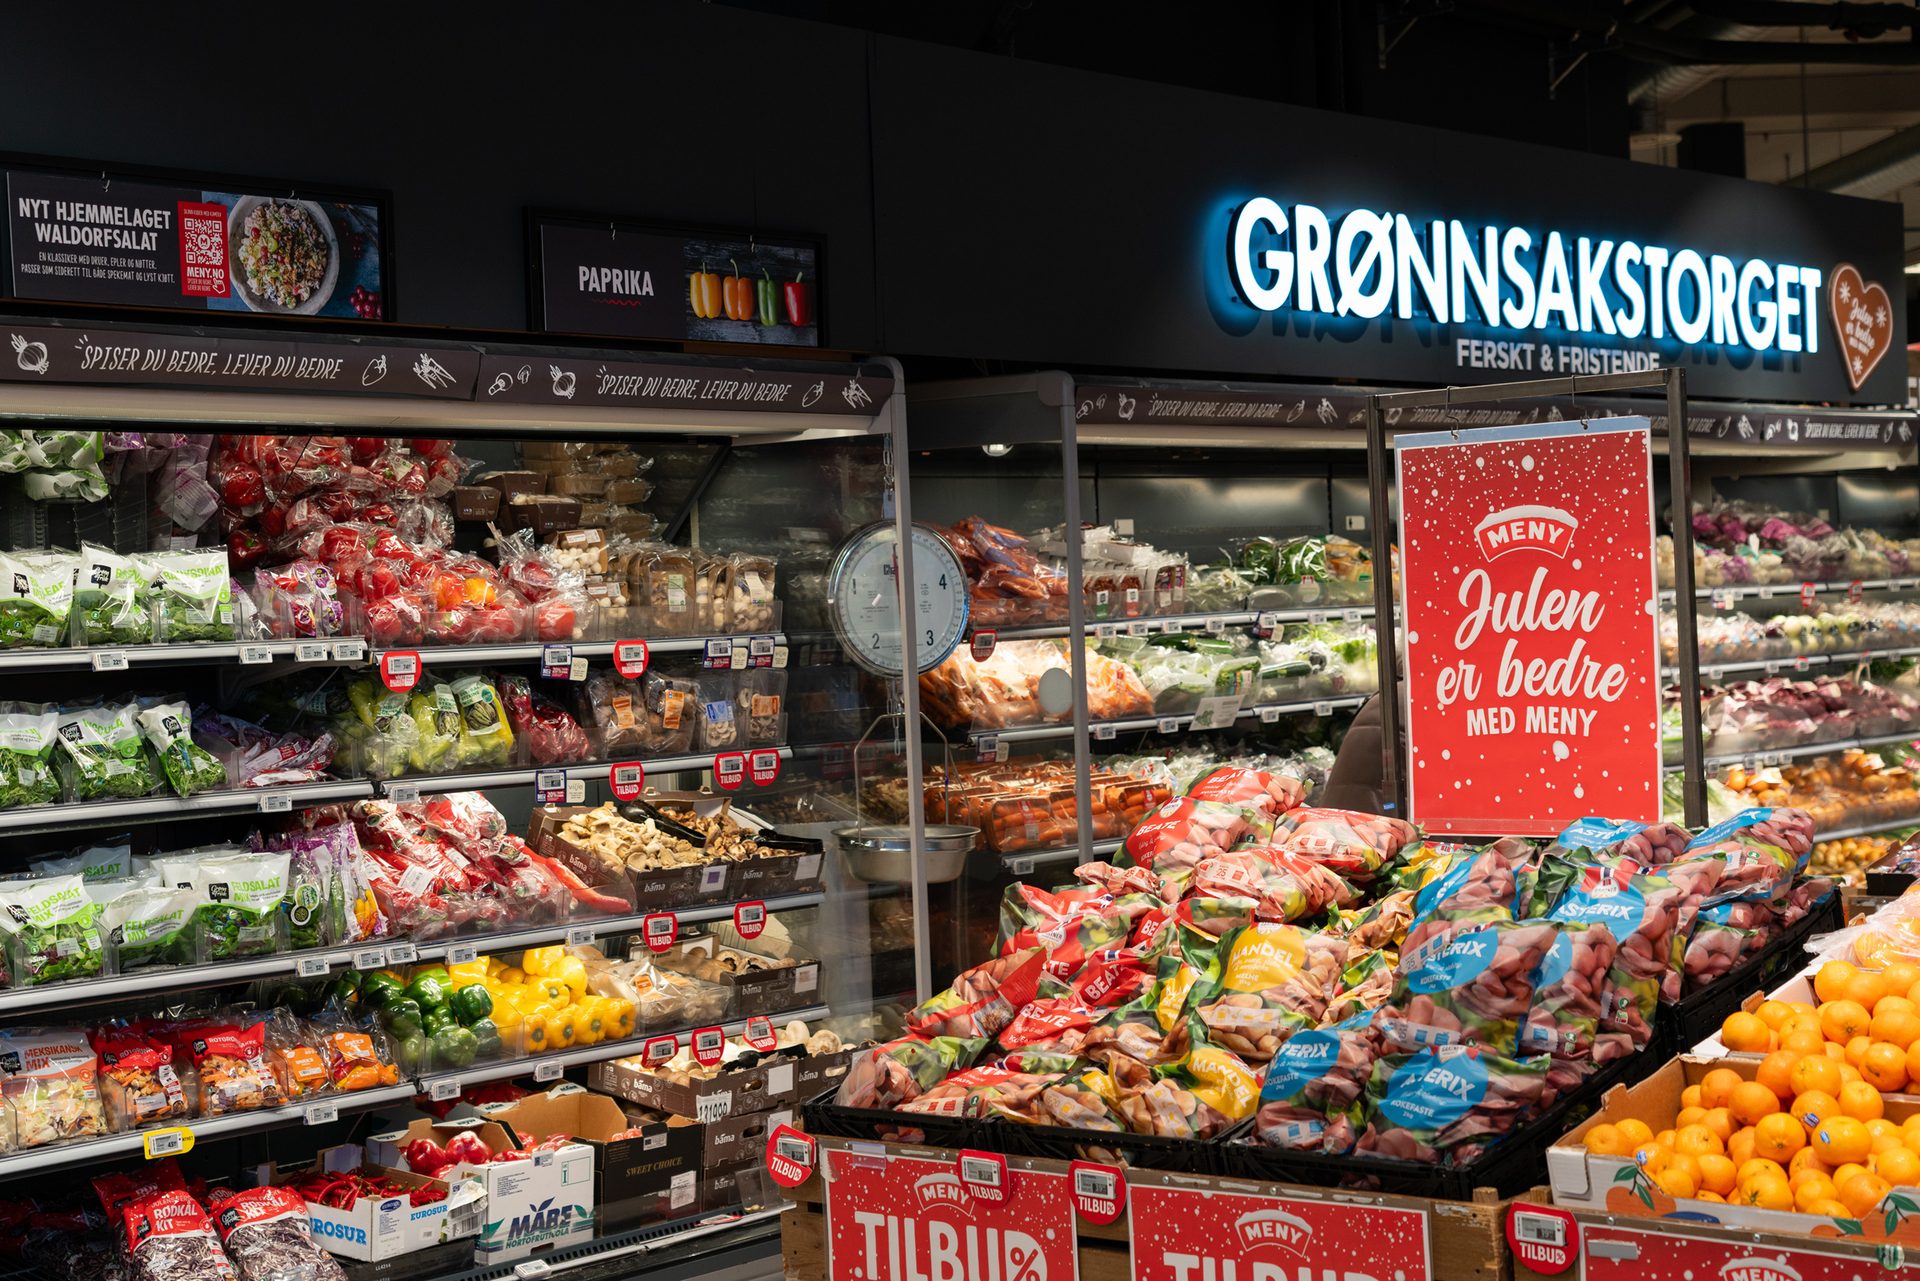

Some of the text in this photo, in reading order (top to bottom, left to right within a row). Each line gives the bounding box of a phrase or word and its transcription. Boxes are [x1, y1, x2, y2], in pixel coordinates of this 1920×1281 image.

[18, 197, 171, 230] NYT HJEMMELAGET
[35, 222, 158, 251] WALDORFSALAT
[39, 251, 47, 261] EN
[110, 257, 127, 268] EPLER
[21, 263, 41, 274] PASSER
[41, 265, 54, 275] SOM
[54, 266, 80, 277] SIDERETT
[82, 267, 92, 278] TIL
[107, 270, 135, 281] SPEKEMAT
[186, 266, 225, 279] MENY.NO
[578, 265, 654, 296] PAPRIKA
[1233, 196, 1822, 354] GRØNNSAKSTORGET
[81, 344, 344, 380] SPISER DU BEDRE, LEVER DU BEDRE
[1456, 338, 1660, 374] FERSKT & FRISTENDE
[598, 373, 792, 403] SPISER DU BEDRE, LEVER DU BEDRE
[1486, 519, 1565, 549] MENY
[938, 573, 947, 590] 4
[1454, 566, 1606, 651] Julen
[872, 632, 880, 650] 2
[926, 629, 934, 646] 3
[1436, 637, 1630, 706] er bedre
[1466, 705, 1598, 738] MED MENY
[719, 774, 742, 784] TILBUD
[752, 770, 775, 780] TILBUD
[615, 785, 639, 795] TILBUD
[1136, 819, 1182, 837] BEATE
[124, 909, 185, 932] FELDSALAT
[740, 923, 762, 933] TILBUD
[126, 929, 149, 943] MIX
[648, 935, 672, 946] TILBUD
[1020, 1003, 1072, 1028] BEATE
[752, 1037, 775, 1049] TILBUD
[25, 1057, 51, 1072] MIX
[697, 1049, 721, 1060] TILBUD
[1192, 1057, 1254, 1108] MANDEL
[625, 1156, 683, 1178] SWEET CHOICE
[771, 1155, 803, 1182] TILBUD
[922, 1183, 970, 1205] MENY
[967, 1183, 1003, 1202] TILBUD
[153, 1199, 198, 1220] RØDKÅL
[410, 1204, 448, 1221] EUROSUR
[1077, 1195, 1116, 1216] TILBUD
[156, 1219, 174, 1232] KIT
[1244, 1220, 1303, 1246] MENY
[1519, 1242, 1566, 1265] TILBUD
